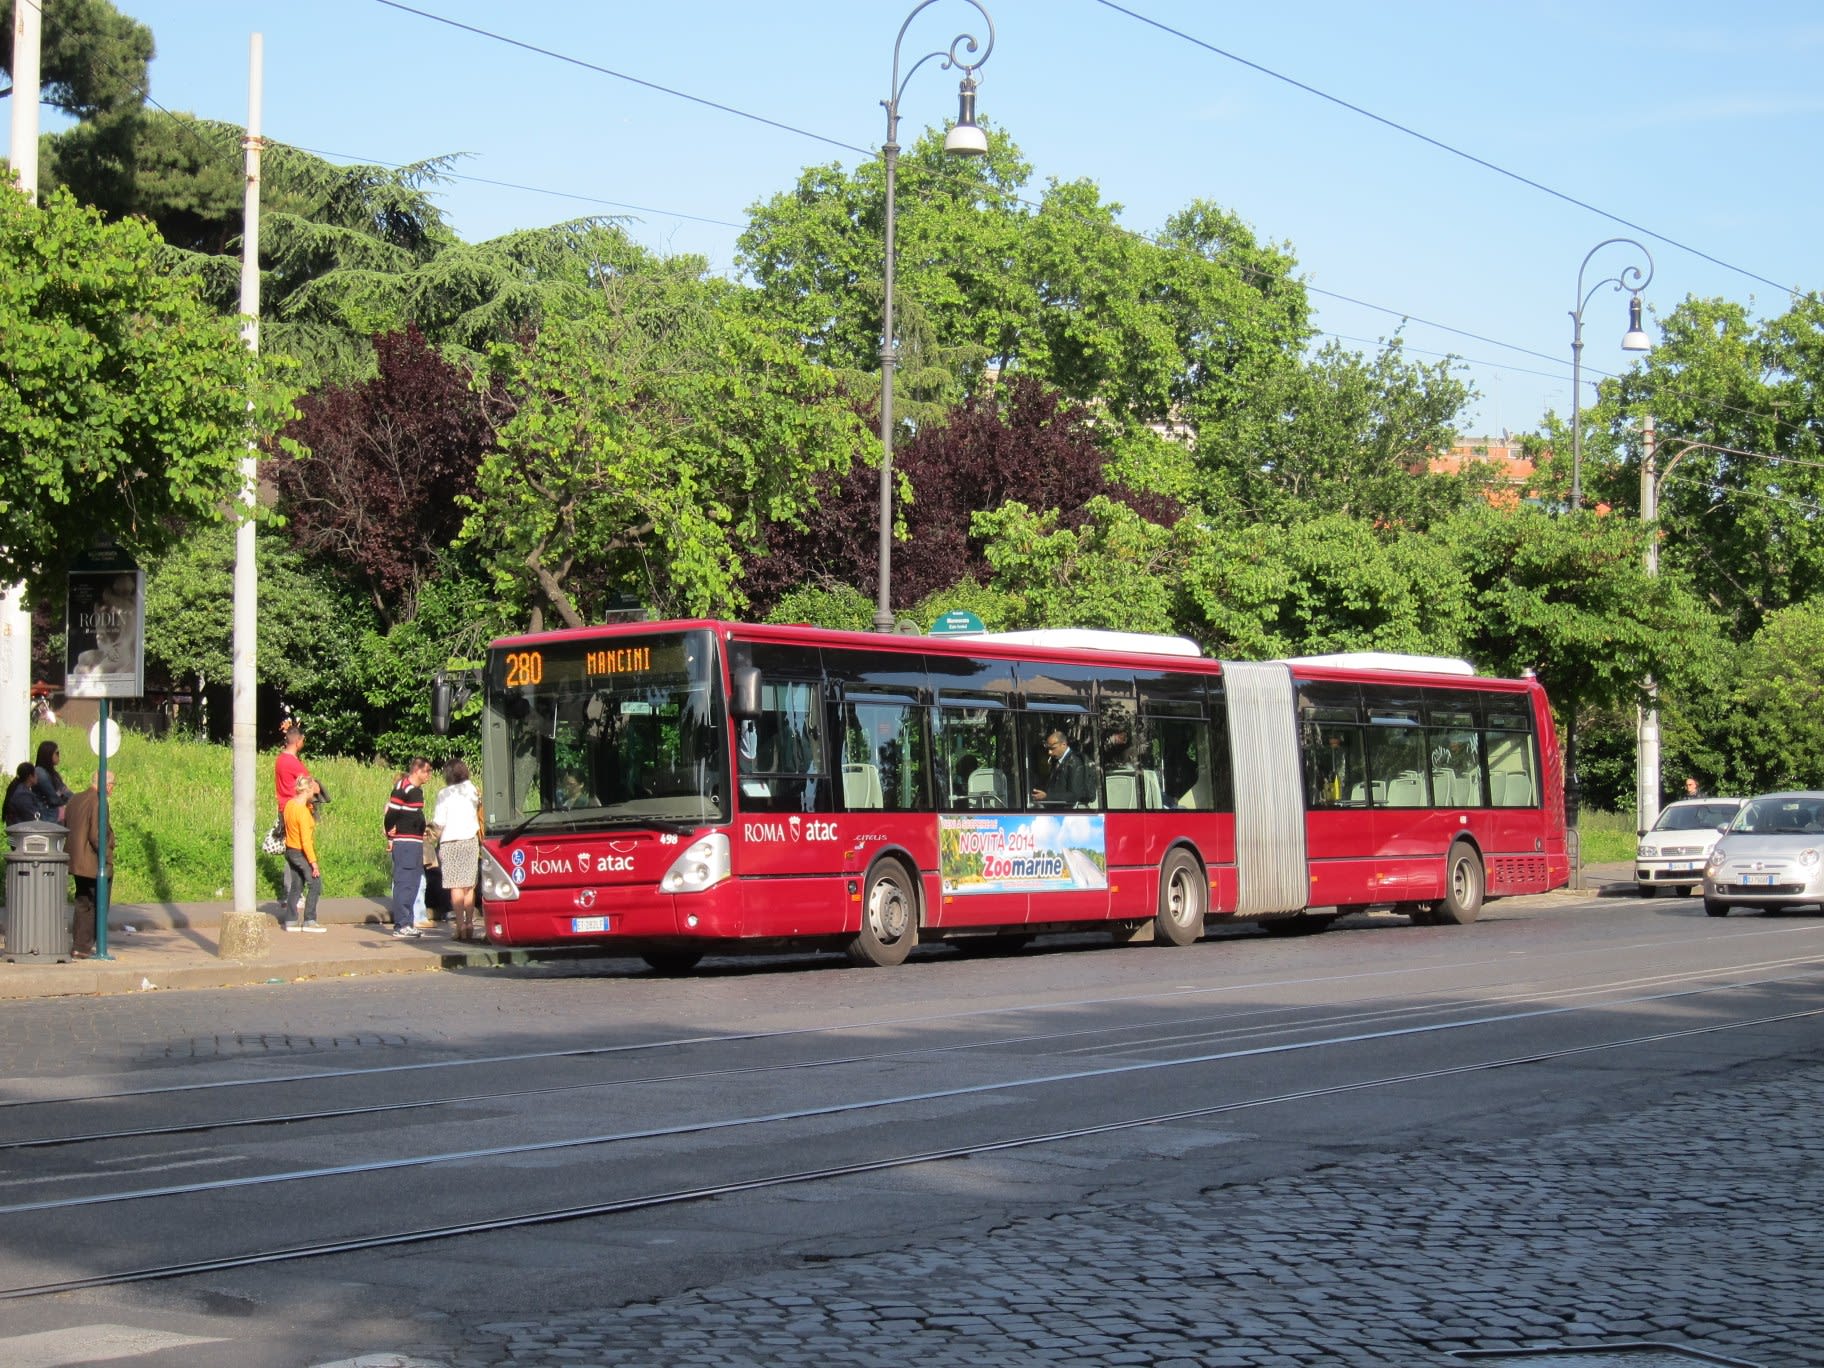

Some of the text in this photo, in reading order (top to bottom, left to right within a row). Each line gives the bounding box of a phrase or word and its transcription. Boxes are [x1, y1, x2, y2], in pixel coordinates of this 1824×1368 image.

[80, 612, 127, 628] RODIN
[506, 648, 650, 687] 280 MANCINI
[660, 833, 679, 845] 498
[744, 820, 838, 842] ROMA atac
[959, 828, 1035, 853] NOVITÀ 2014
[531, 855, 634, 875] ROMA atac
[984, 853, 1063, 878] Zoomarine
